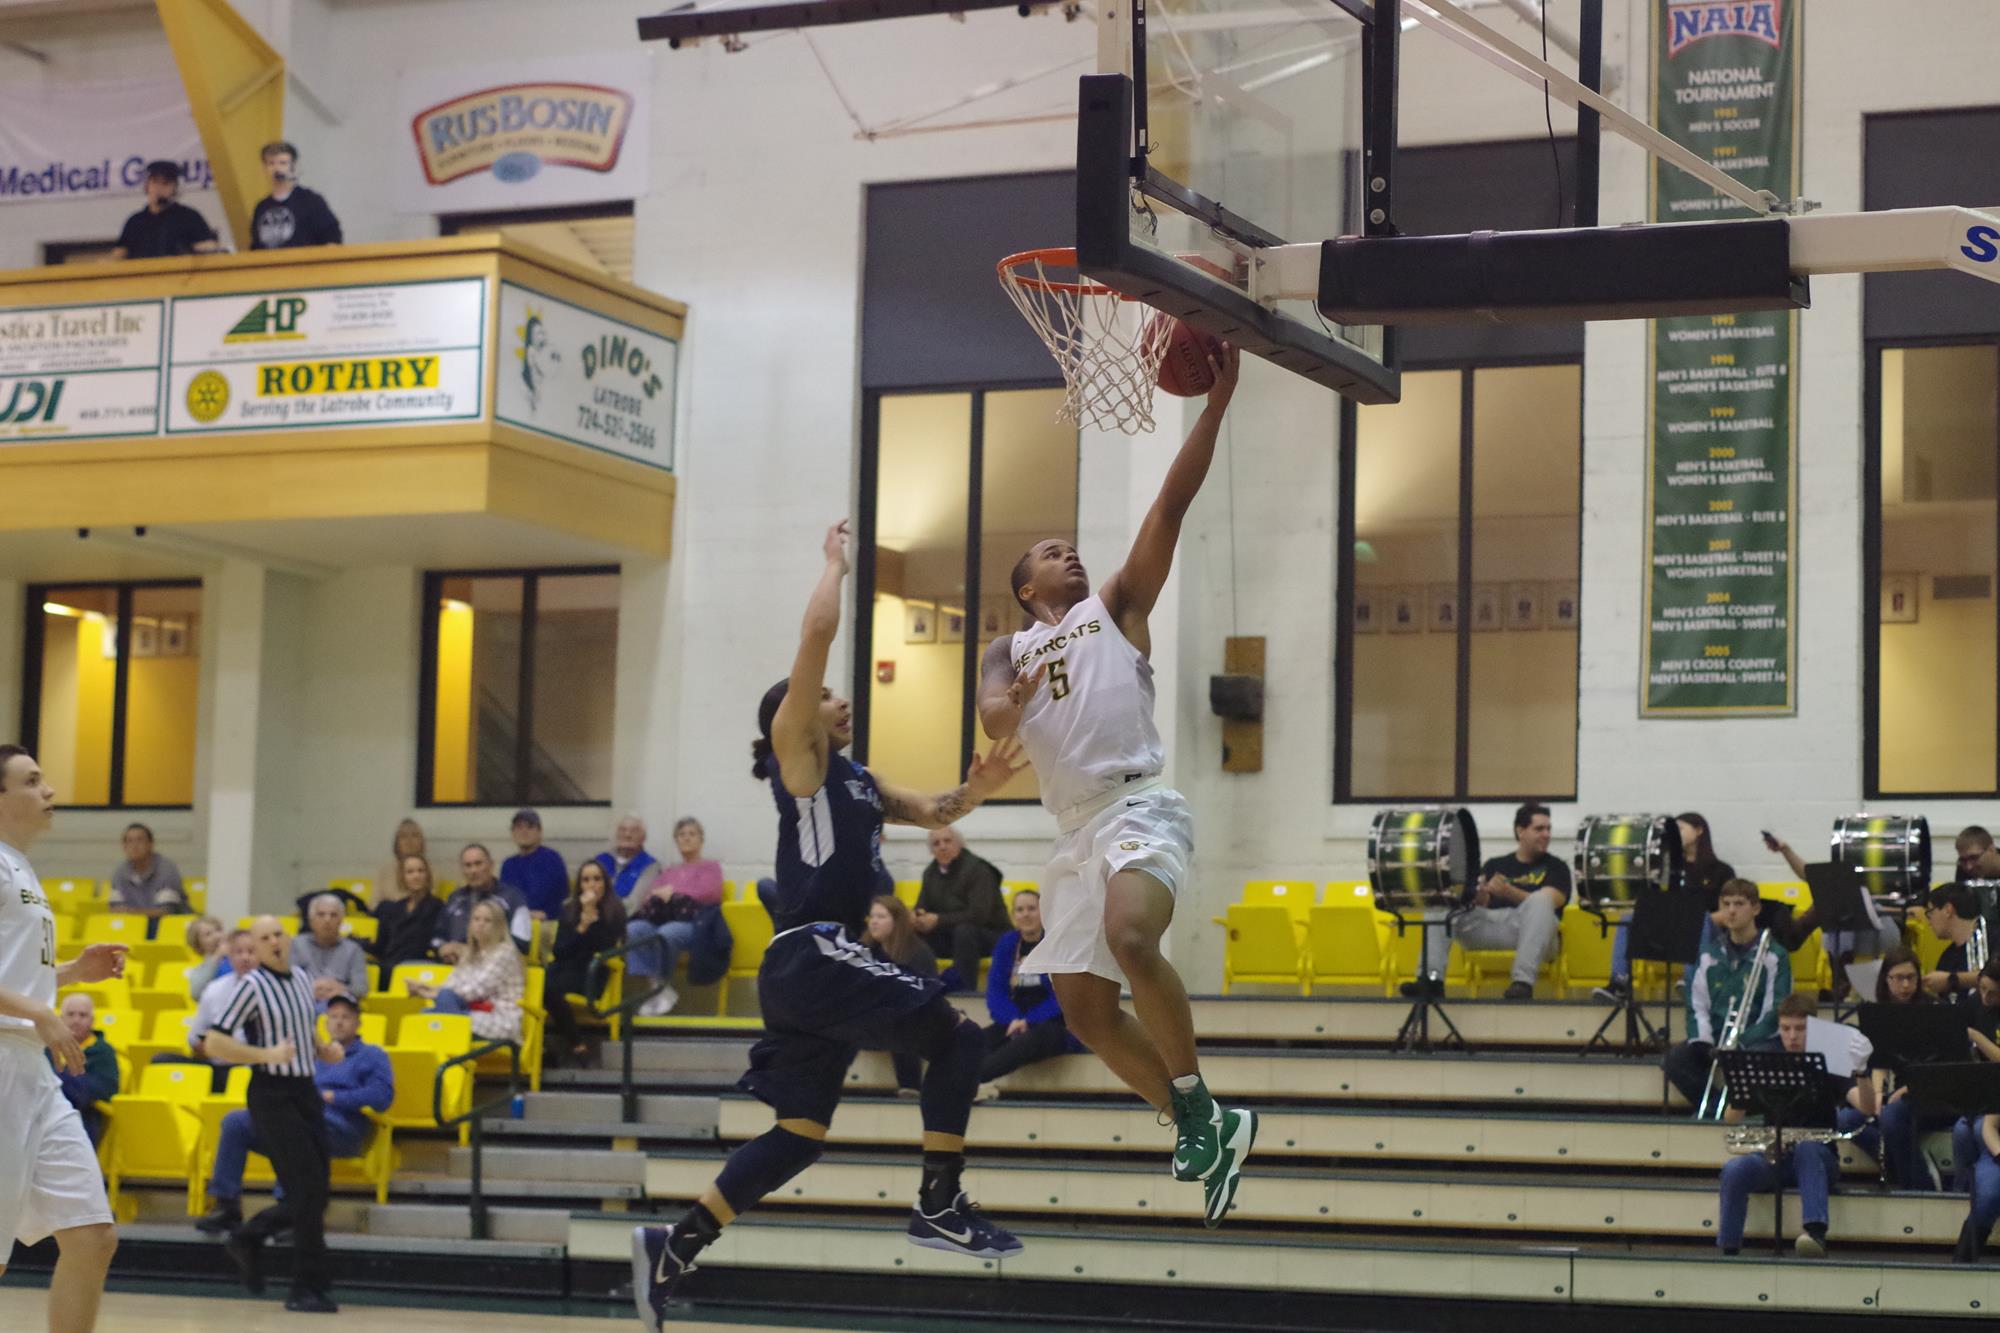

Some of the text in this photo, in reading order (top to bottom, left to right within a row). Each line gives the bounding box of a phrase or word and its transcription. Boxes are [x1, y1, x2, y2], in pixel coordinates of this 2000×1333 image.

[1673, 4, 1776, 45] NAIA
[1688, 67, 1762, 84] NATIONAL
[1675, 82, 1775, 103] TOURNAMENT
[1688, 117, 1760, 132] MEN'S SOCCER
[0, 160, 109, 195] Medical
[1668, 326, 1775, 341] WOMEN'S BASKETBALL
[582, 335, 663, 399] DINO'S
[1658, 369, 1687, 381] MEN'S
[1690, 367, 1747, 380] BASKETBALL
[263, 358, 434, 394] ROTARY
[1669, 379, 1774, 393] WOMEN'S BASKETBALL
[241, 391, 453, 418] Serving the Latrobe Community
[594, 387, 642, 416] LATROBE
[1668, 419, 1774, 433] WOMEN'S BASKETBALL
[1676, 458, 1765, 471] MEN'S BASKETBALL
[1667, 472, 1774, 486] WOMEN'S BASKETBALL
[1656, 515, 1686, 525] MEN'S
[1689, 513, 1743, 525] BASKETBALL
[1752, 511, 1776, 522] ELITE
[1654, 554, 1682, 565] MEN'S
[1685, 553, 1737, 564] BASKETBALL
[1743, 552, 1774, 562] SWEET
[1666, 566, 1774, 578] WOMEN'S BASKETBALL
[1663, 605, 1776, 617] MEN'S CROSS COUNTRY
[1652, 620, 1681, 631] MEN'S
[1684, 620, 1736, 630] BASKETBALL
[1743, 619, 1773, 629] SWEET
[1015, 620, 1101, 672] BEARCATS
[1661, 658, 1776, 670] MEN'S CROSS COUNTRY
[1047, 657, 1071, 700] 5
[1650, 673, 1679, 684] MEN'S
[1681, 673, 1736, 683] BASKETBALL
[1743, 672, 1773, 682] SWEET
